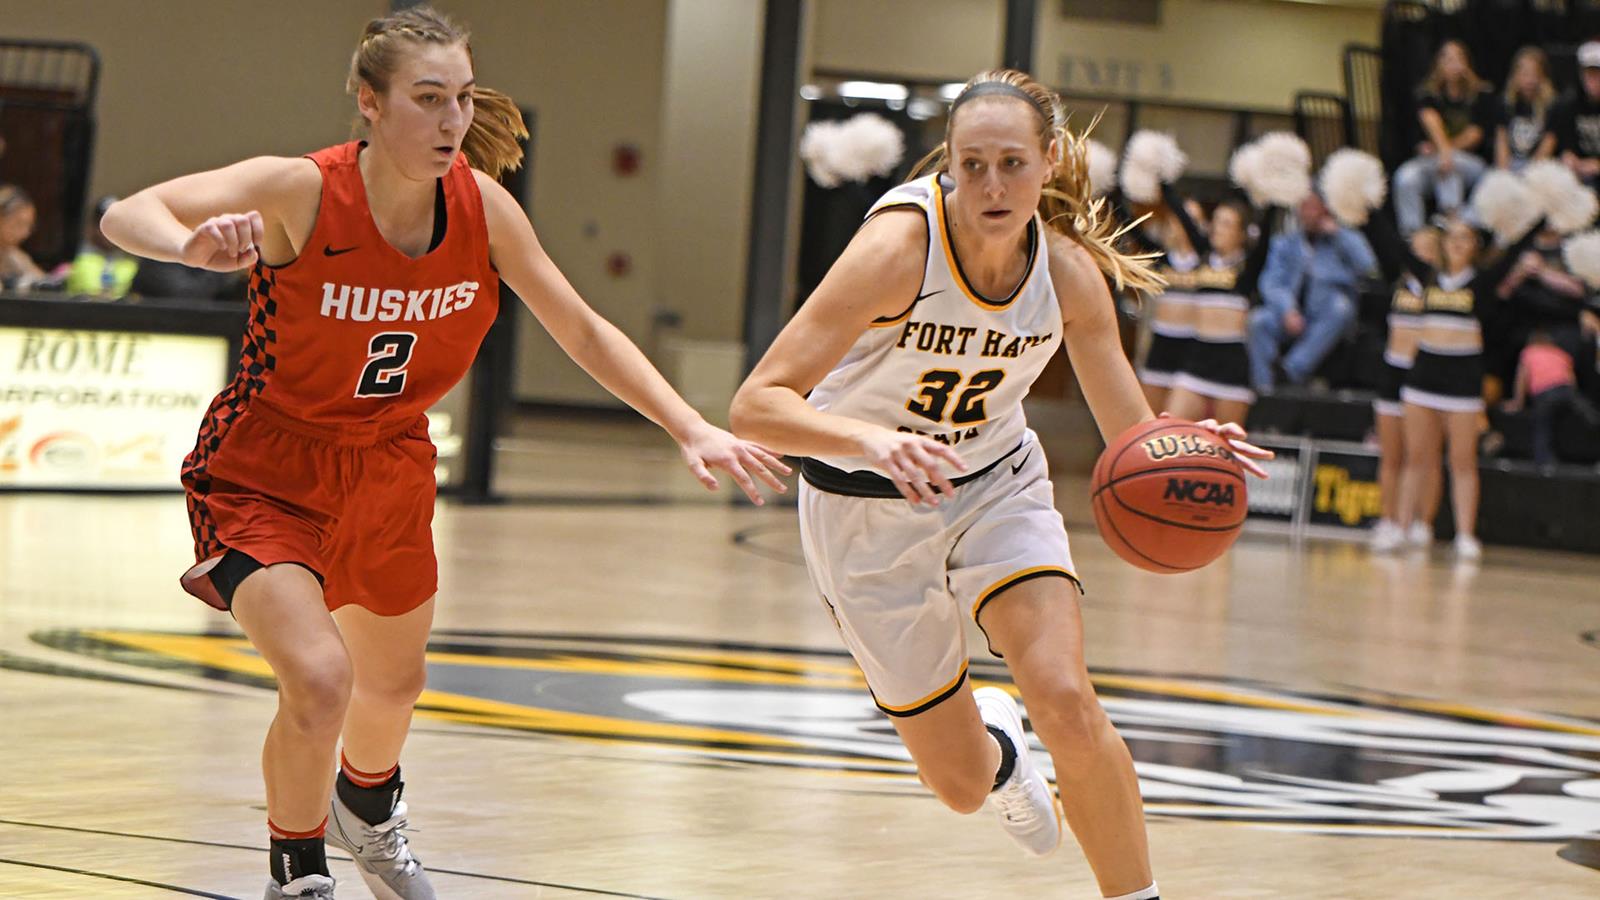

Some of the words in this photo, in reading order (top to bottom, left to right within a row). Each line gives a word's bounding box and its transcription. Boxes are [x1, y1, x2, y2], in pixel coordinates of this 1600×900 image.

[320, 281, 479, 322] HUSKIES
[16, 331, 148, 376] ROME
[896, 321, 977, 356] FORT
[354, 331, 418, 398] 2
[0, 384, 202, 410] RPORATION
[904, 368, 1007, 427] 32
[1163, 478, 1235, 506] NCAA
